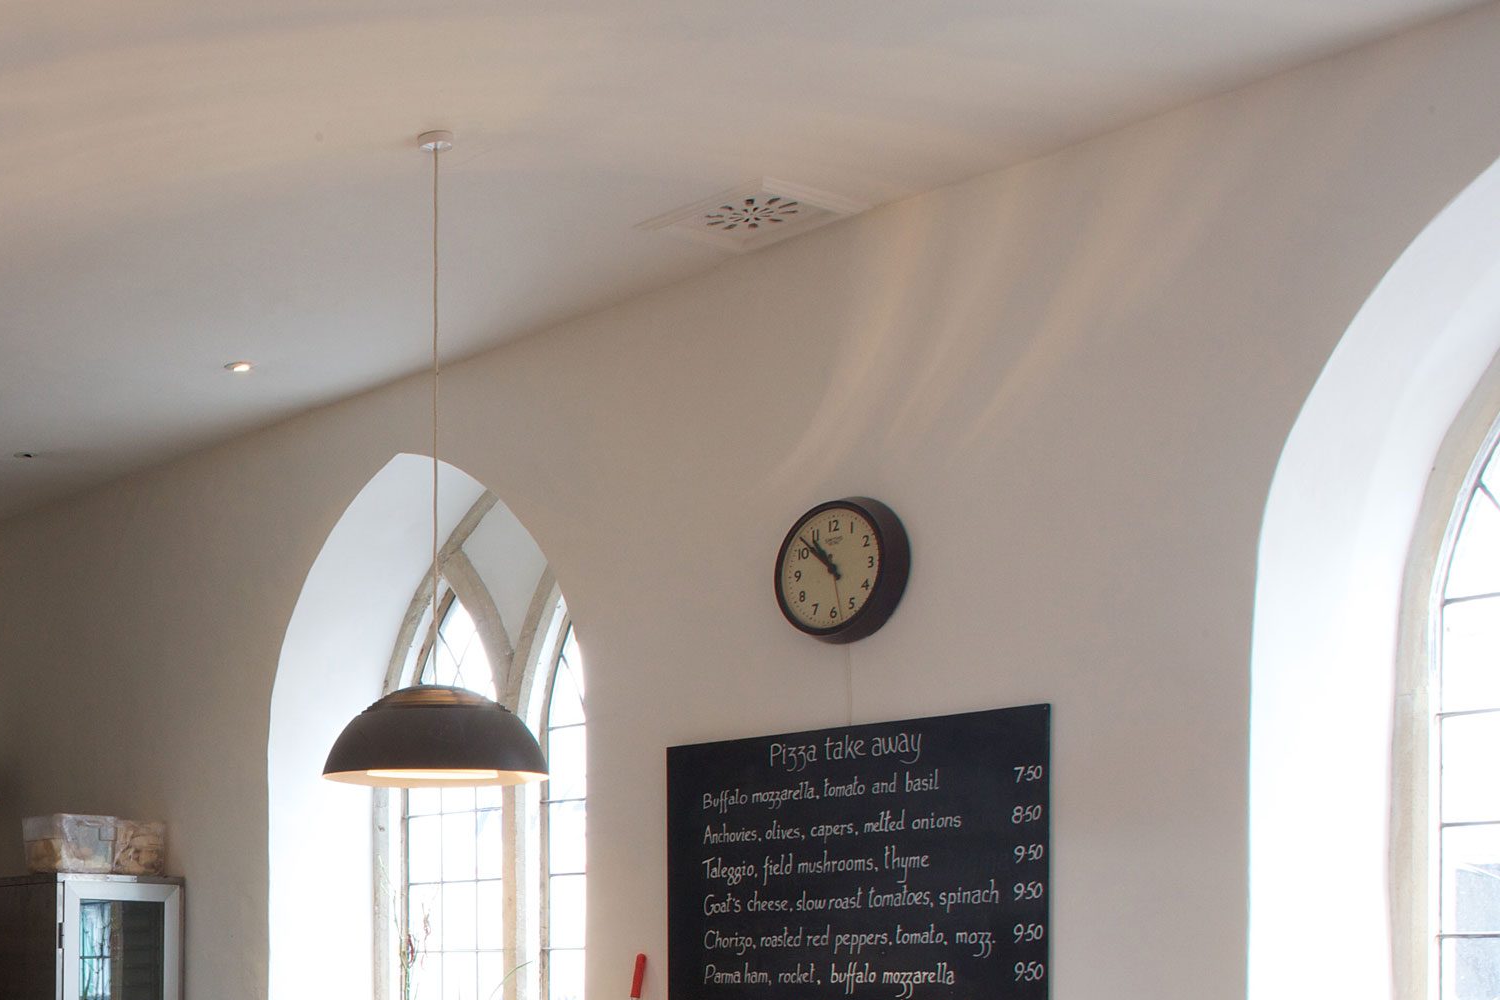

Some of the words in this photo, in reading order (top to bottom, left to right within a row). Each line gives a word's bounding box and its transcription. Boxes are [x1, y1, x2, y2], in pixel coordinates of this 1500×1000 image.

[828, 520, 840, 532] 12
[850, 521, 854, 534] 1
[862, 535, 870, 547] 2
[797, 547, 810, 560] 10
[867, 556, 874, 568] 3
[794, 571, 802, 582] 9
[861, 579, 870, 591] 4
[799, 591, 806, 602] 8
[812, 603, 818, 615] 7
[848, 597, 855, 609] 5
[829, 607, 837, 618] 6
[770, 743, 817, 772] Pizza
[825, 735, 866, 760] take
[871, 733, 922, 765] away
[703, 788, 748, 814] Buffalo
[823, 775, 866, 798] tomato
[871, 772, 898, 794] and
[905, 768, 940, 793] basil
[765, 820, 806, 841] olives,
[864, 809, 905, 833] melted
[912, 812, 963, 830] onions
[763, 853, 793, 886] field
[884, 845, 930, 883] thyme
[703, 893, 741, 916] Goat's
[796, 890, 826, 911] slow
[829, 887, 863, 910] roast
[868, 885, 934, 908] tomatoes,
[938, 879, 1000, 914] spinach
[760, 926, 803, 948] roasted
[806, 924, 830, 946] red
[955, 931, 996, 959] mozz.
[703, 963, 741, 985] Parma
[744, 962, 772, 986] ham,
[778, 963, 821, 986] rocket,
[830, 962, 876, 994] buffalo
[882, 962, 955, 999] mozzarella
